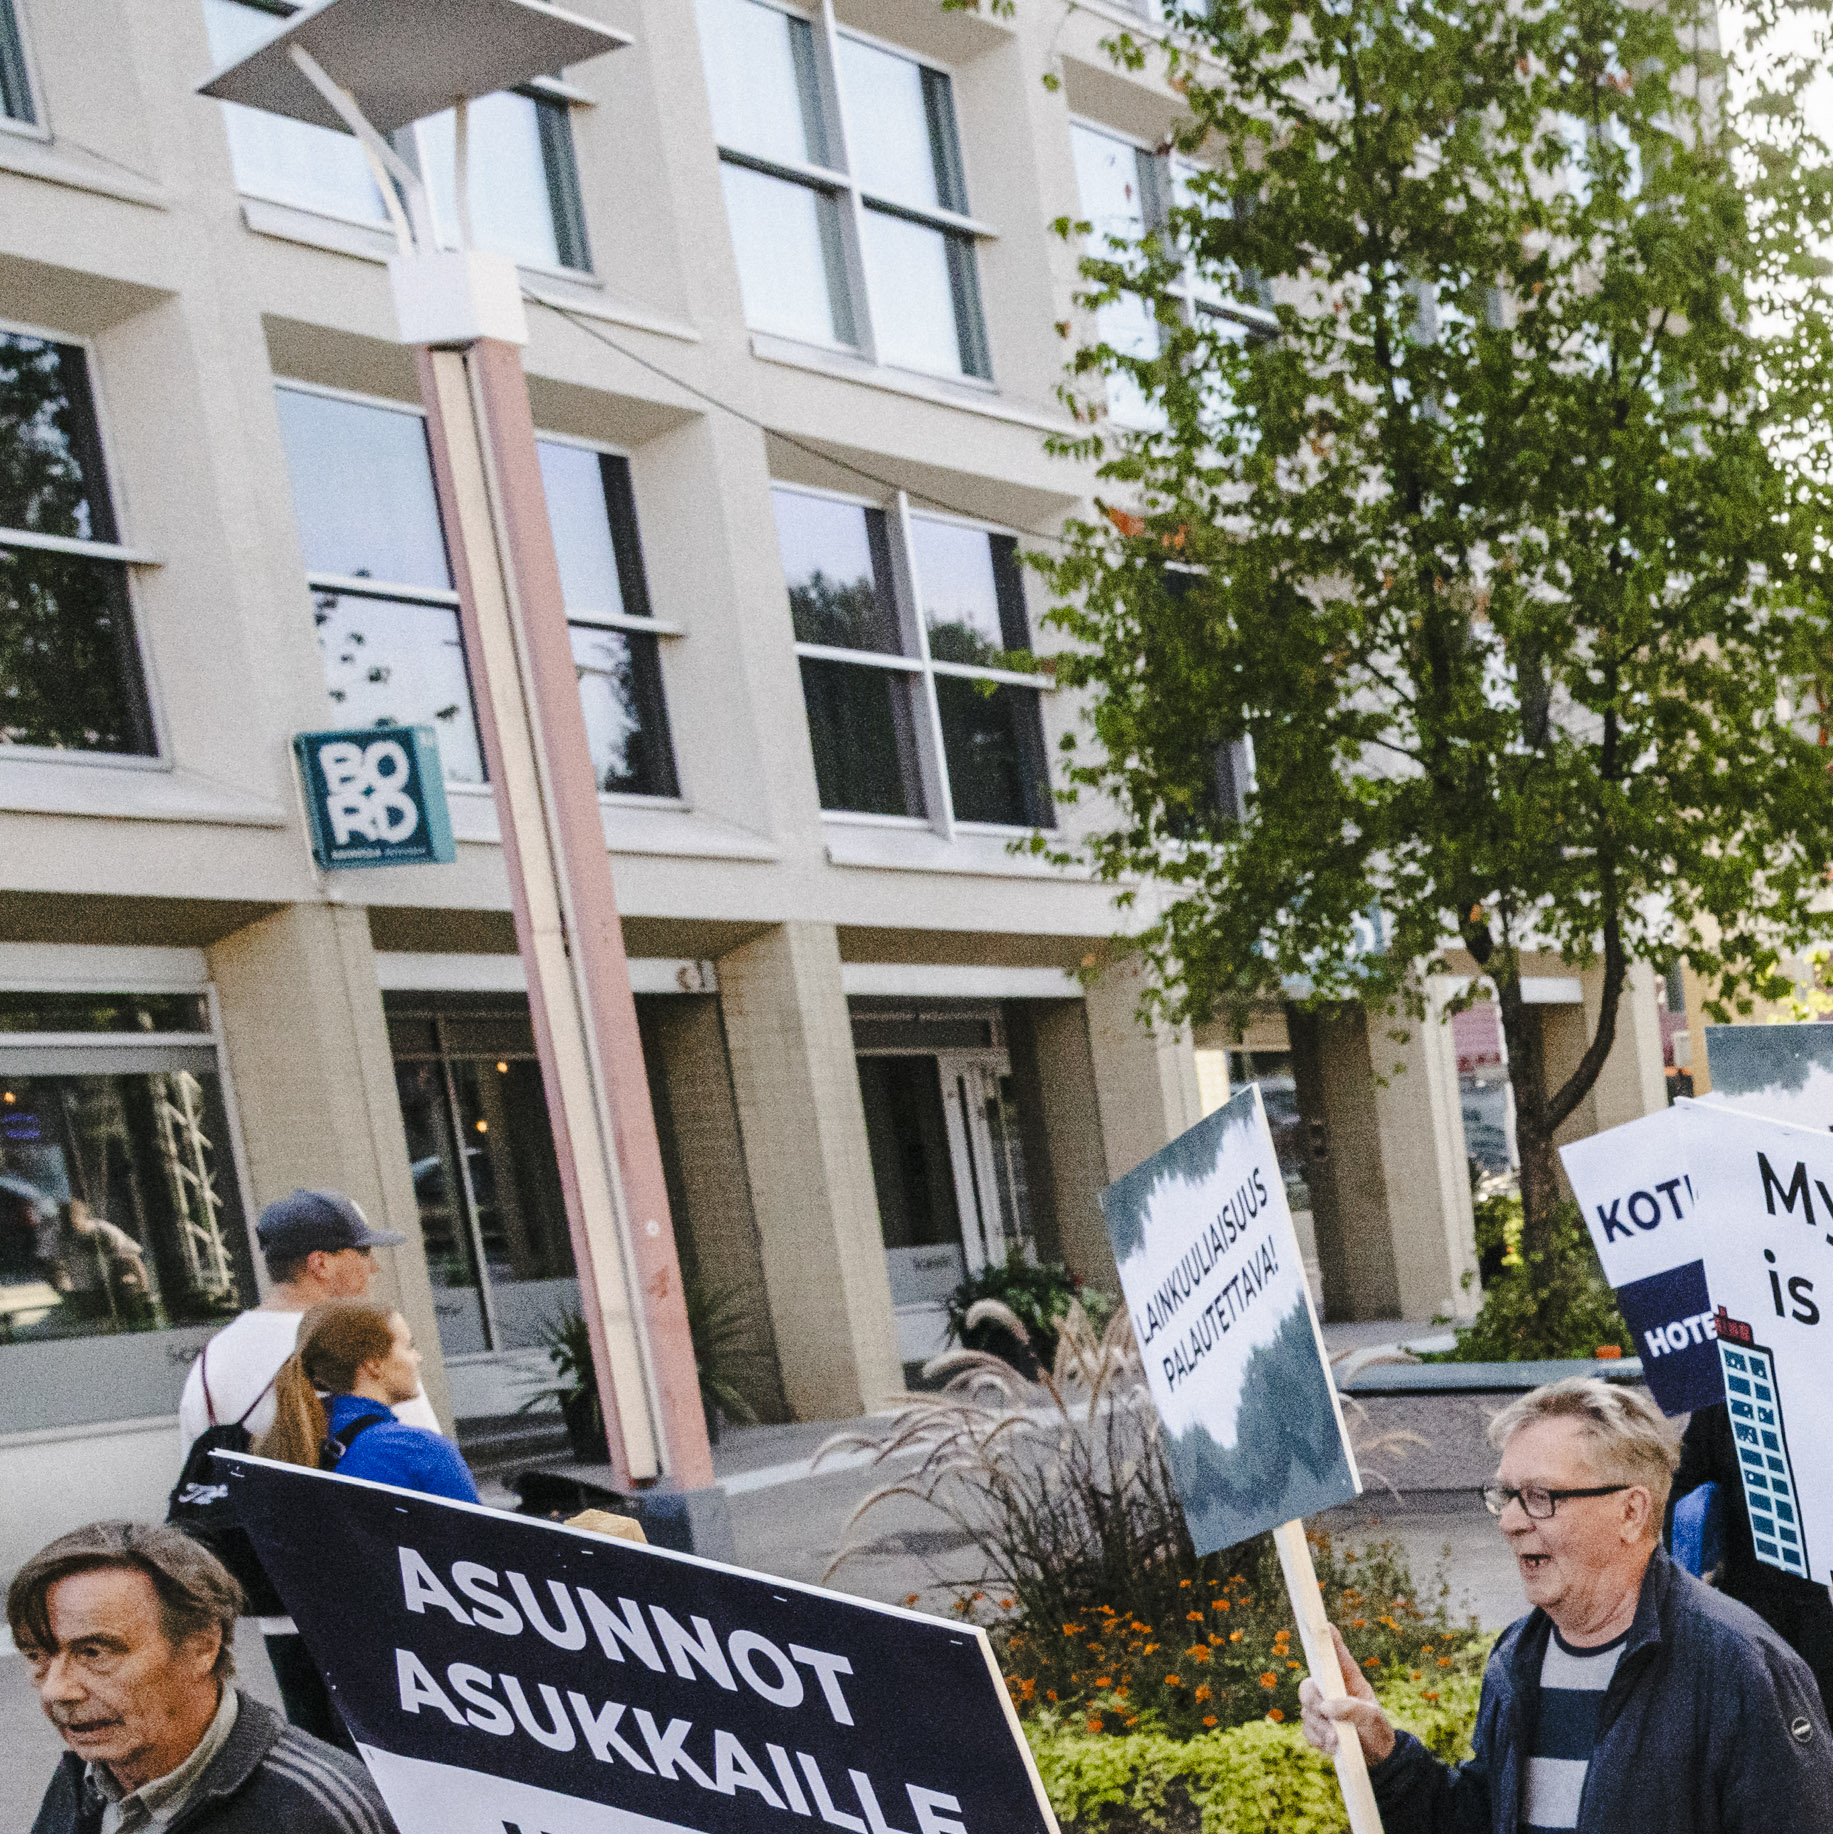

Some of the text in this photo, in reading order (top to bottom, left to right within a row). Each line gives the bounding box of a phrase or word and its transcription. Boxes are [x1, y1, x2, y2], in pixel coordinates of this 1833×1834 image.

[1135, 1167, 1268, 1346] LAINKUULIAISUUS
[1162, 1234, 1280, 1393] PALAUTETTAVA!
[1643, 1310, 1718, 1359] HOTE
[1763, 1248, 1821, 1326] is
[398, 1546, 855, 1726] ASUNNOT
